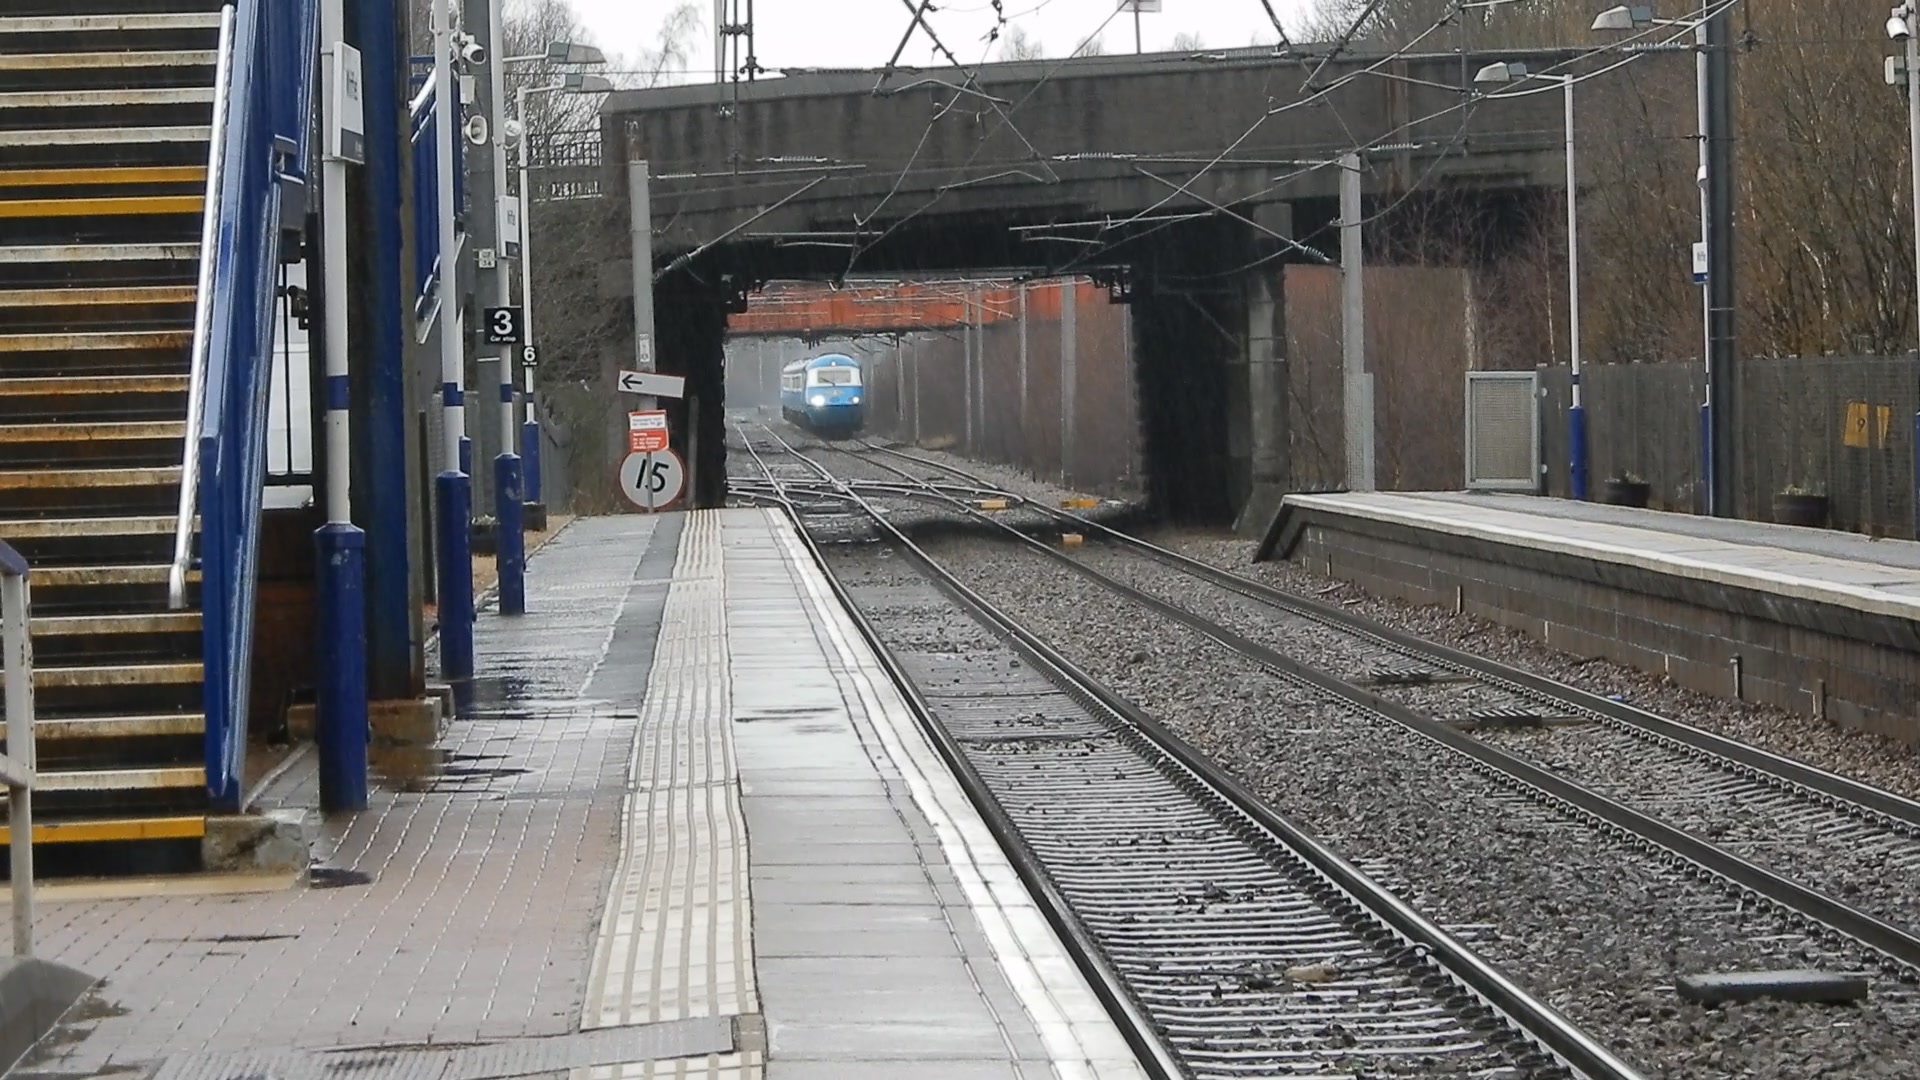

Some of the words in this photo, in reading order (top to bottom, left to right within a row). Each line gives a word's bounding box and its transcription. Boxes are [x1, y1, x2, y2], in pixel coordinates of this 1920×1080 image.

[493, 310, 513, 335] 3
[523, 346, 536, 361] 6
[635, 459, 669, 492] 15
